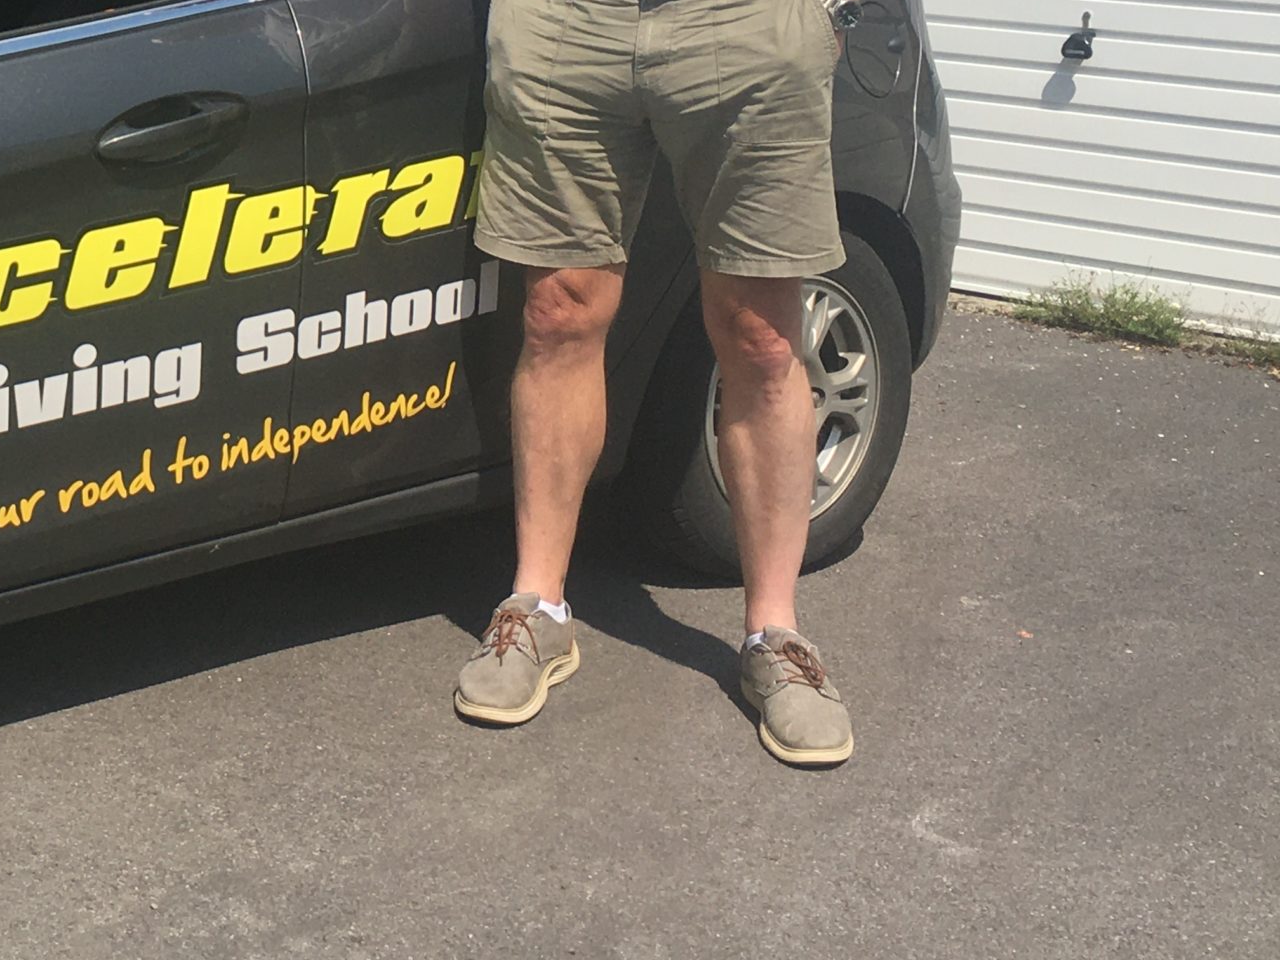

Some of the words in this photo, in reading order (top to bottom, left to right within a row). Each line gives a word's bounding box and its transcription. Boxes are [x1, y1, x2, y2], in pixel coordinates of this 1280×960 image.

[236, 259, 500, 375] School
[58, 450, 156, 513] road
[167, 436, 210, 485] to
[220, 362, 456, 470] independence!
